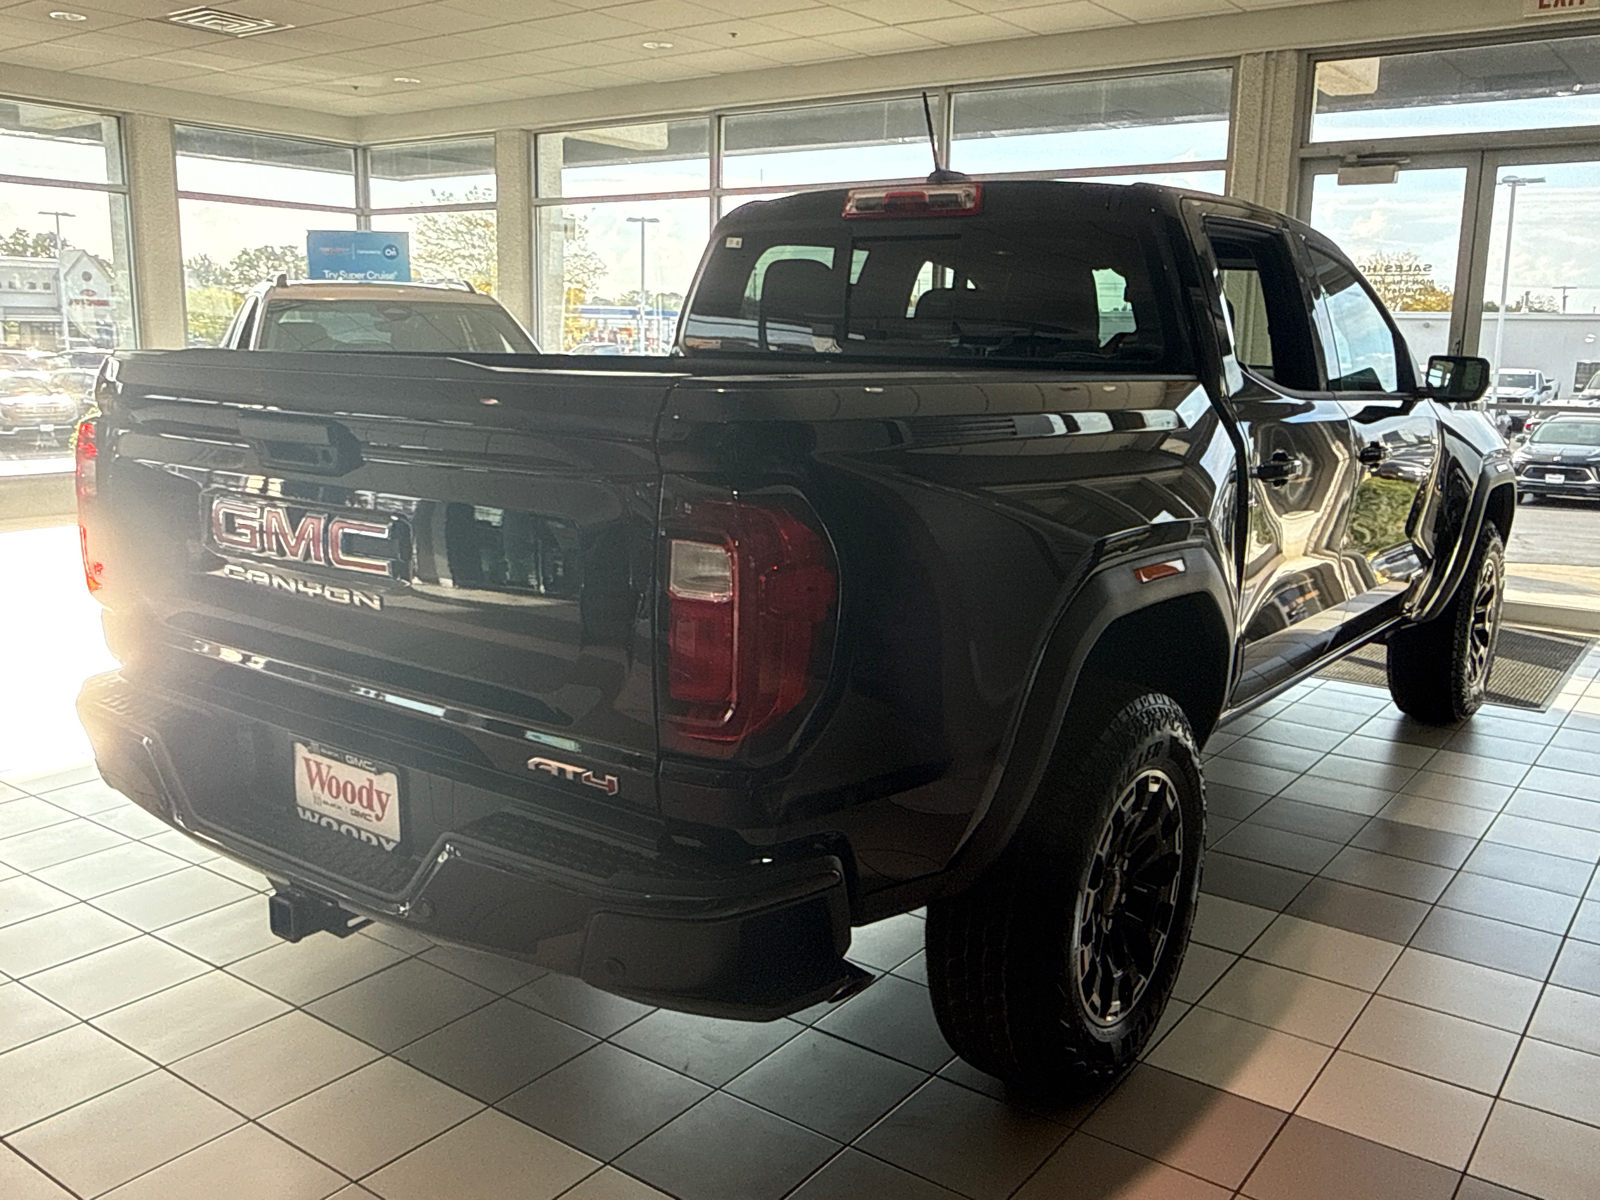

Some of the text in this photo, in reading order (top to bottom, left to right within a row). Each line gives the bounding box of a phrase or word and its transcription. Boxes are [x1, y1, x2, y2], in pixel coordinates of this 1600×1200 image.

[322, 270, 338, 280] Try
[340, 270, 365, 280] Super
[212, 499, 393, 578] GMC
[223, 564, 384, 611] CANYON
[345, 754, 377, 771] GMC
[527, 757, 618, 796] AT4
[301, 756, 392, 822] Woody
[350, 808, 374, 822] GMC
